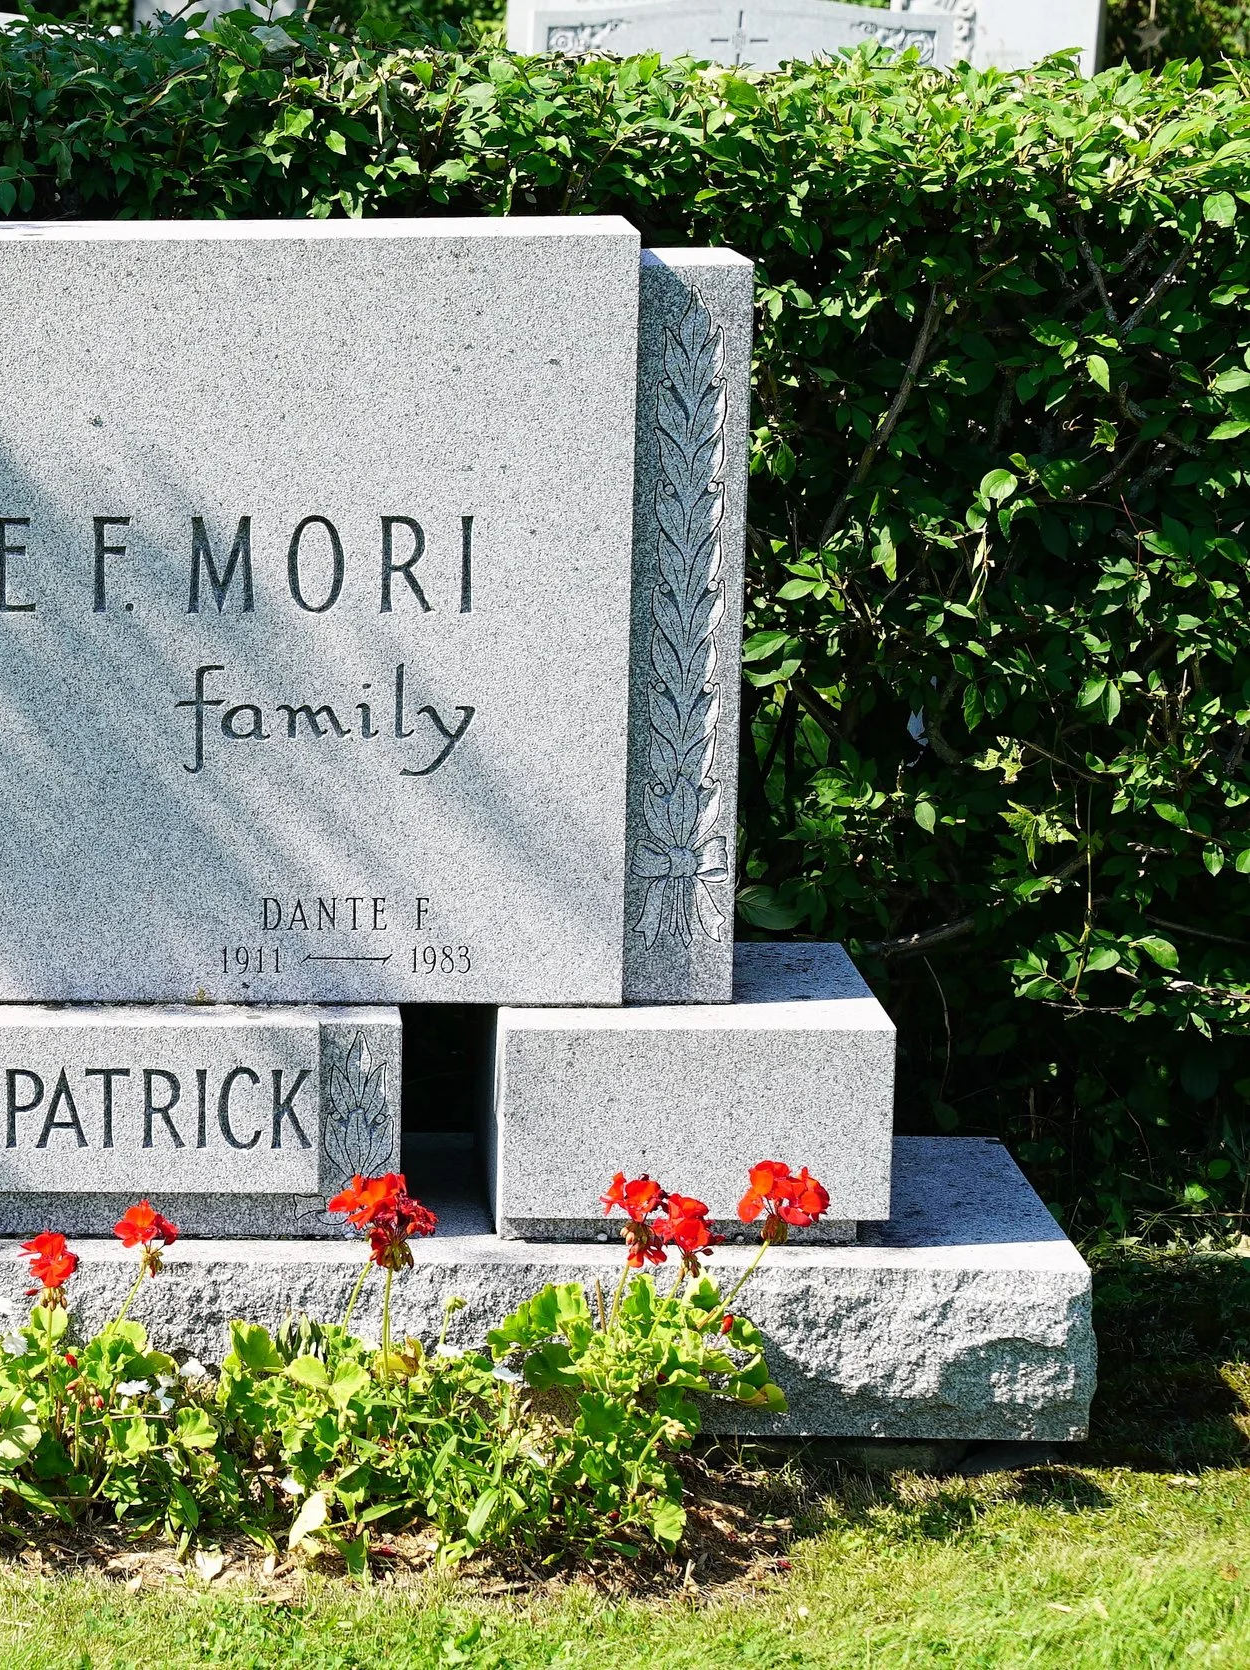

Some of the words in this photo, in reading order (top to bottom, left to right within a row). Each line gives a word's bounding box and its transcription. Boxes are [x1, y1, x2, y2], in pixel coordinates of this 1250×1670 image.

[92, 516, 135, 613] F.
[187, 514, 475, 614] MORI
[175, 662, 476, 776] family
[261, 897, 388, 931] DANTE
[414, 897, 433, 931] F.
[220, 946, 282, 974] 1911
[410, 945, 472, 974] 1983
